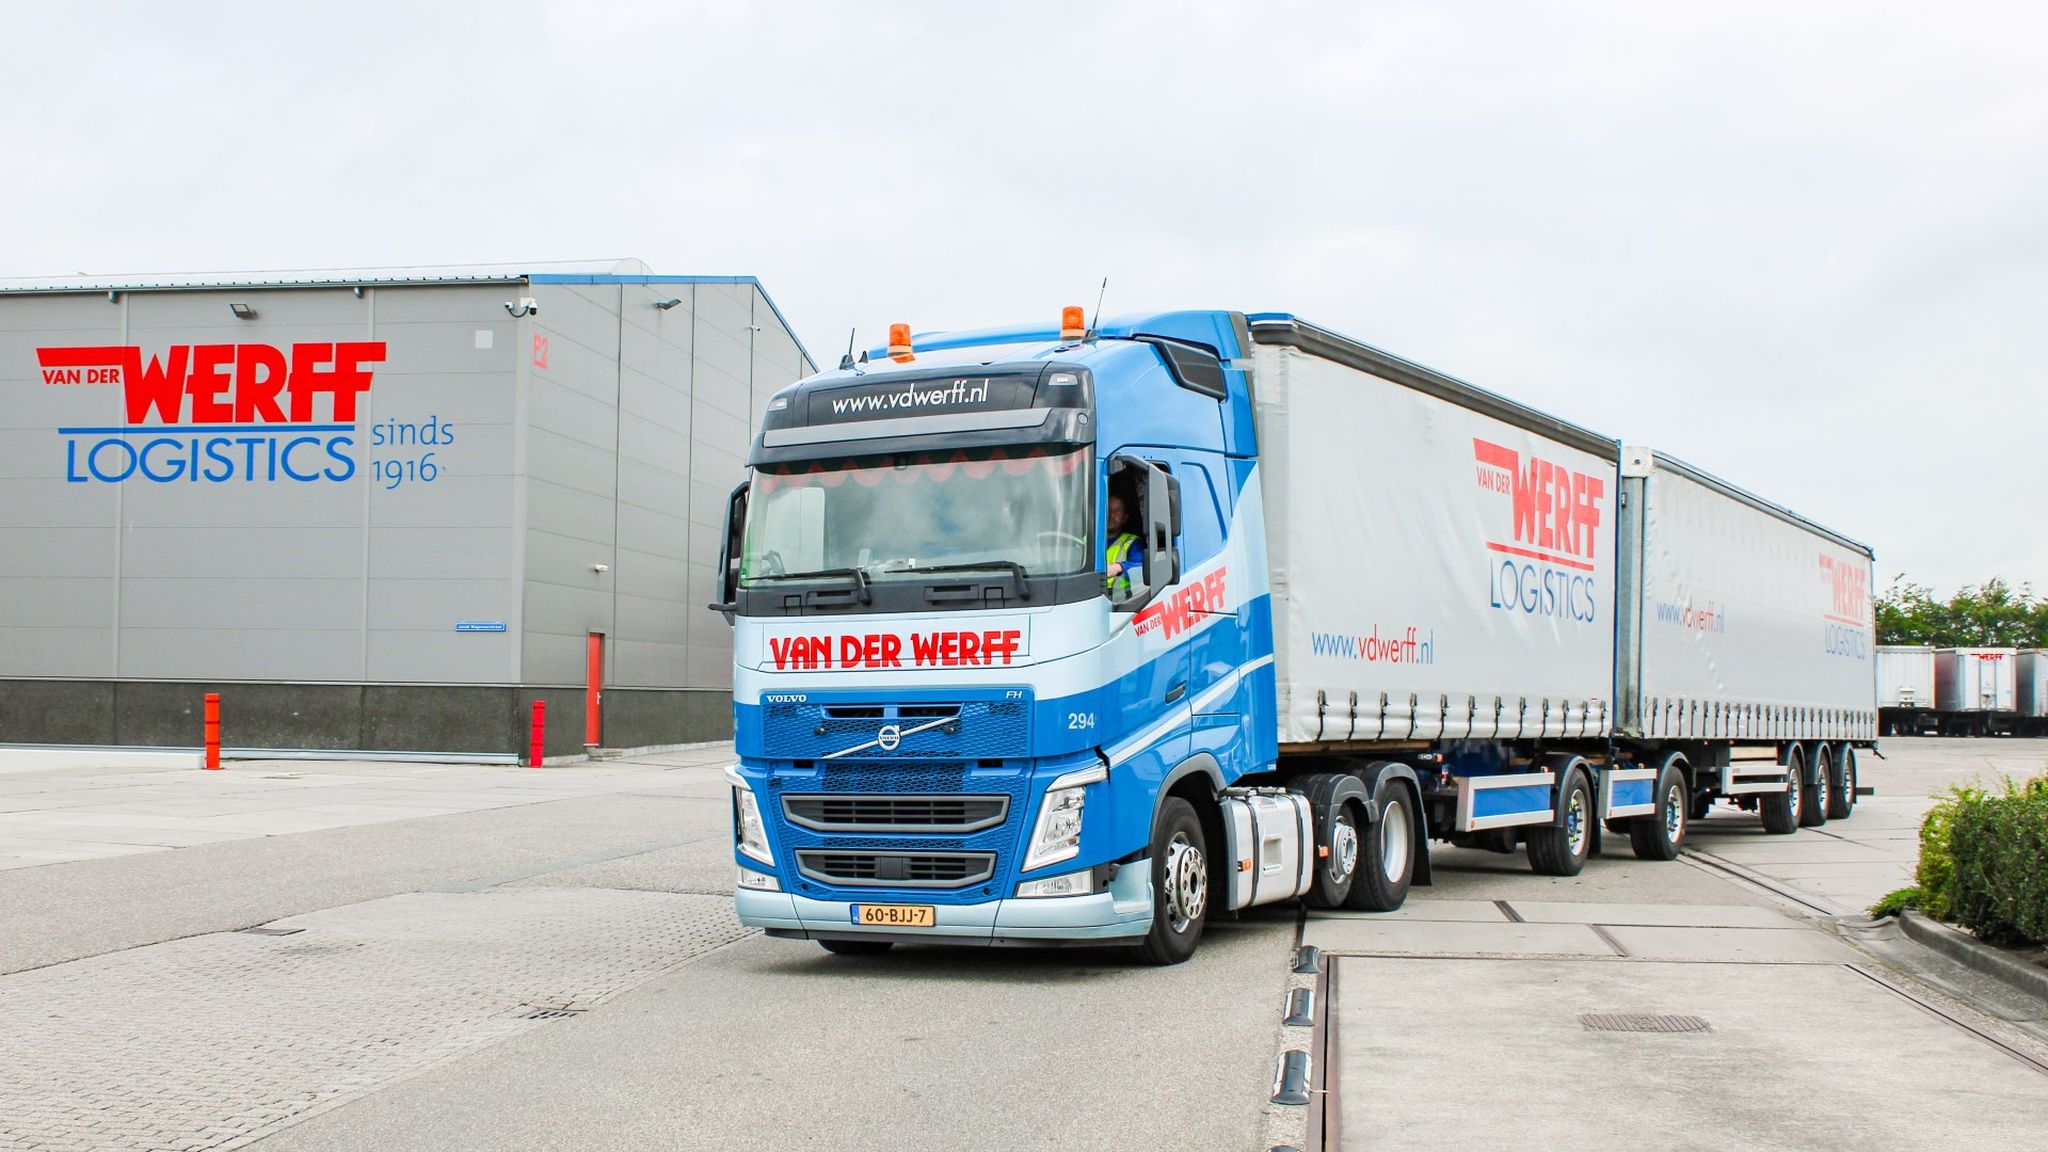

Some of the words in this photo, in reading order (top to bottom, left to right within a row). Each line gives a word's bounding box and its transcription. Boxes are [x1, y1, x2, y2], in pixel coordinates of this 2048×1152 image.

[42, 369, 81, 385] VAN
[86, 368, 120, 384] DER
[115, 341, 387, 424] WERFF
[832, 378, 990, 415] www.vdwerff.nl
[371, 415, 455, 447] sinds
[66, 436, 356, 483] LOGISTICS
[372, 452, 438, 489] 1916
[1476, 466, 1494, 491] VAN
[1495, 472, 1511, 495] DER
[1508, 450, 1604, 559] WERFF
[1134, 622, 1150, 637] VAN
[1158, 566, 1227, 640] WERFF
[1490, 558, 1595, 623] LOGISTICS
[770, 636, 832, 670] VAN
[840, 634, 903, 669] DER
[910, 630, 1021, 667] WERFF
[1311, 623, 1434, 665] www.vdwerff.nl
[766, 694, 807, 703] VOLVO
[1006, 690, 1022, 699] FH
[1068, 712, 1096, 730] 294
[865, 907, 927, 923] 60-BJJ-7
